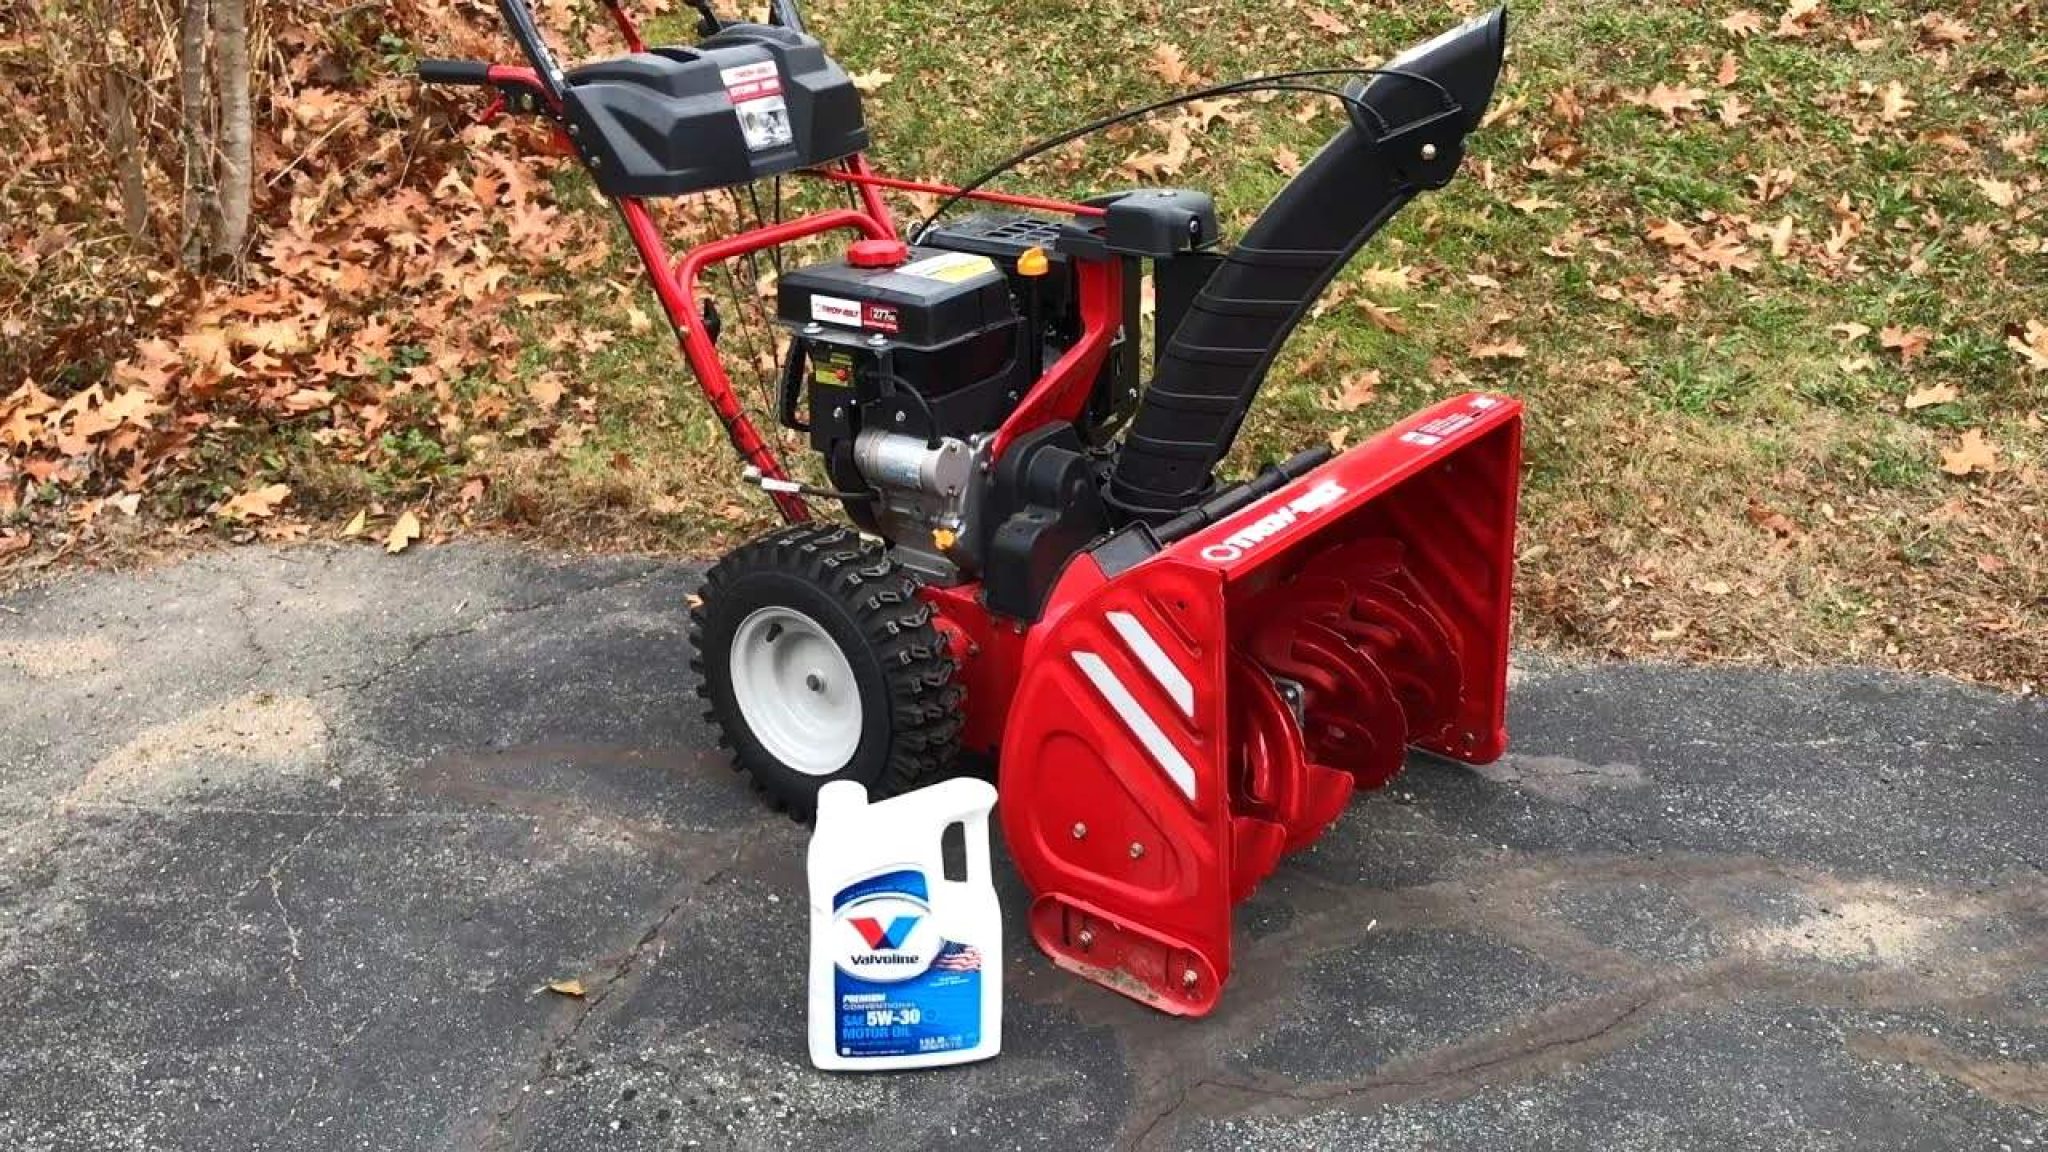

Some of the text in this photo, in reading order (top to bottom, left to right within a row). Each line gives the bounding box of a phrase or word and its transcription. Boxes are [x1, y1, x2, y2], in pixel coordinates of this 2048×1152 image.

[851, 954, 919, 965] Valvoline
[866, 1008, 921, 1026] 5W-30
[843, 1026, 911, 1040] MOTOR OIL
